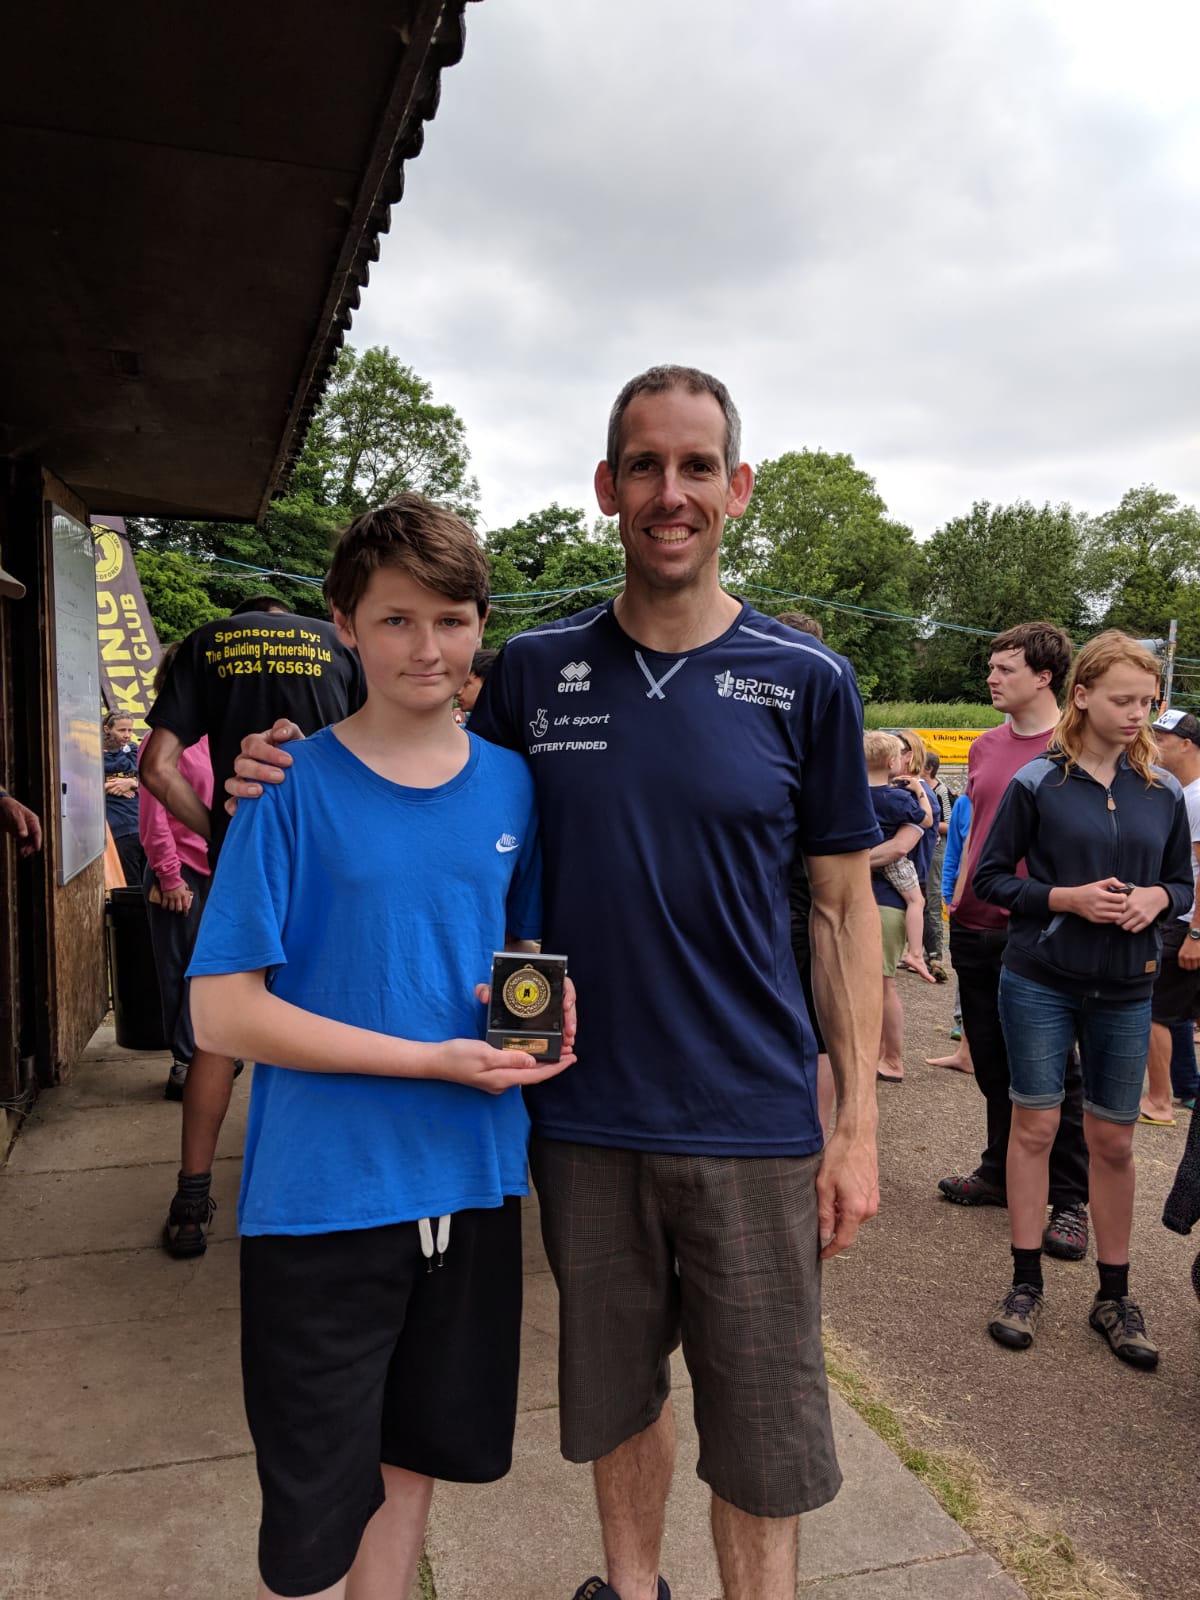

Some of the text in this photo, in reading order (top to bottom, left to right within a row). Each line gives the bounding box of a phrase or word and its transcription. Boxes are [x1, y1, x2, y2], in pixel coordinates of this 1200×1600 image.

[119, 593, 152, 661] CLUB
[215, 628, 321, 643] Sponsored by:
[205, 642, 332, 665] The Building Partnership Ltd
[217, 660, 322, 678] 01234 765636
[735, 678, 796, 700] BRITISH
[733, 692, 792, 711] CANOEING
[554, 713, 610, 727] uk sport
[933, 734, 978, 742] Viking Kaya
[529, 741, 608, 755] LOTTERY FUNDED
